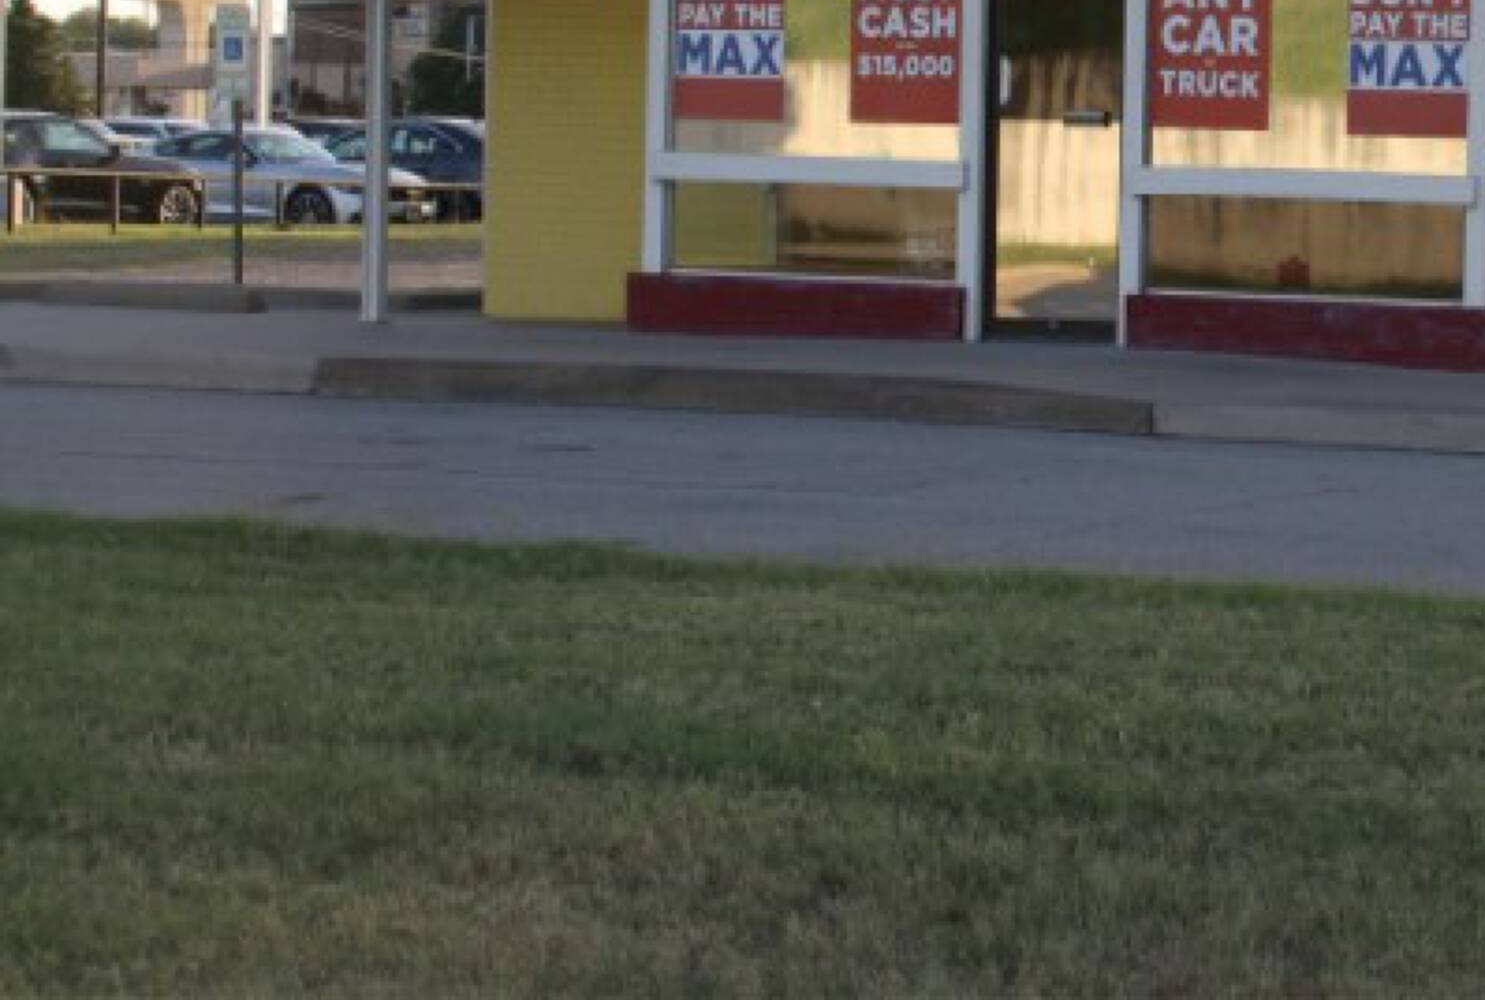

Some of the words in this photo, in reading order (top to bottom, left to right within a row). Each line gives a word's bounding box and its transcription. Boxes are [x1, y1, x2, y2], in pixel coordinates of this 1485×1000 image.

[679, 2, 725, 25] PAY
[734, 3, 782, 27] THE
[859, 6, 956, 38] CASH
[1351, 11, 1402, 37] PAY
[1413, 13, 1468, 39] THE
[1162, 14, 1259, 56] CAR
[677, 32, 781, 76] MAX
[857, 54, 954, 83] $15,000
[1350, 43, 1464, 87] MAX
[1159, 68, 1260, 98] TRUCK
